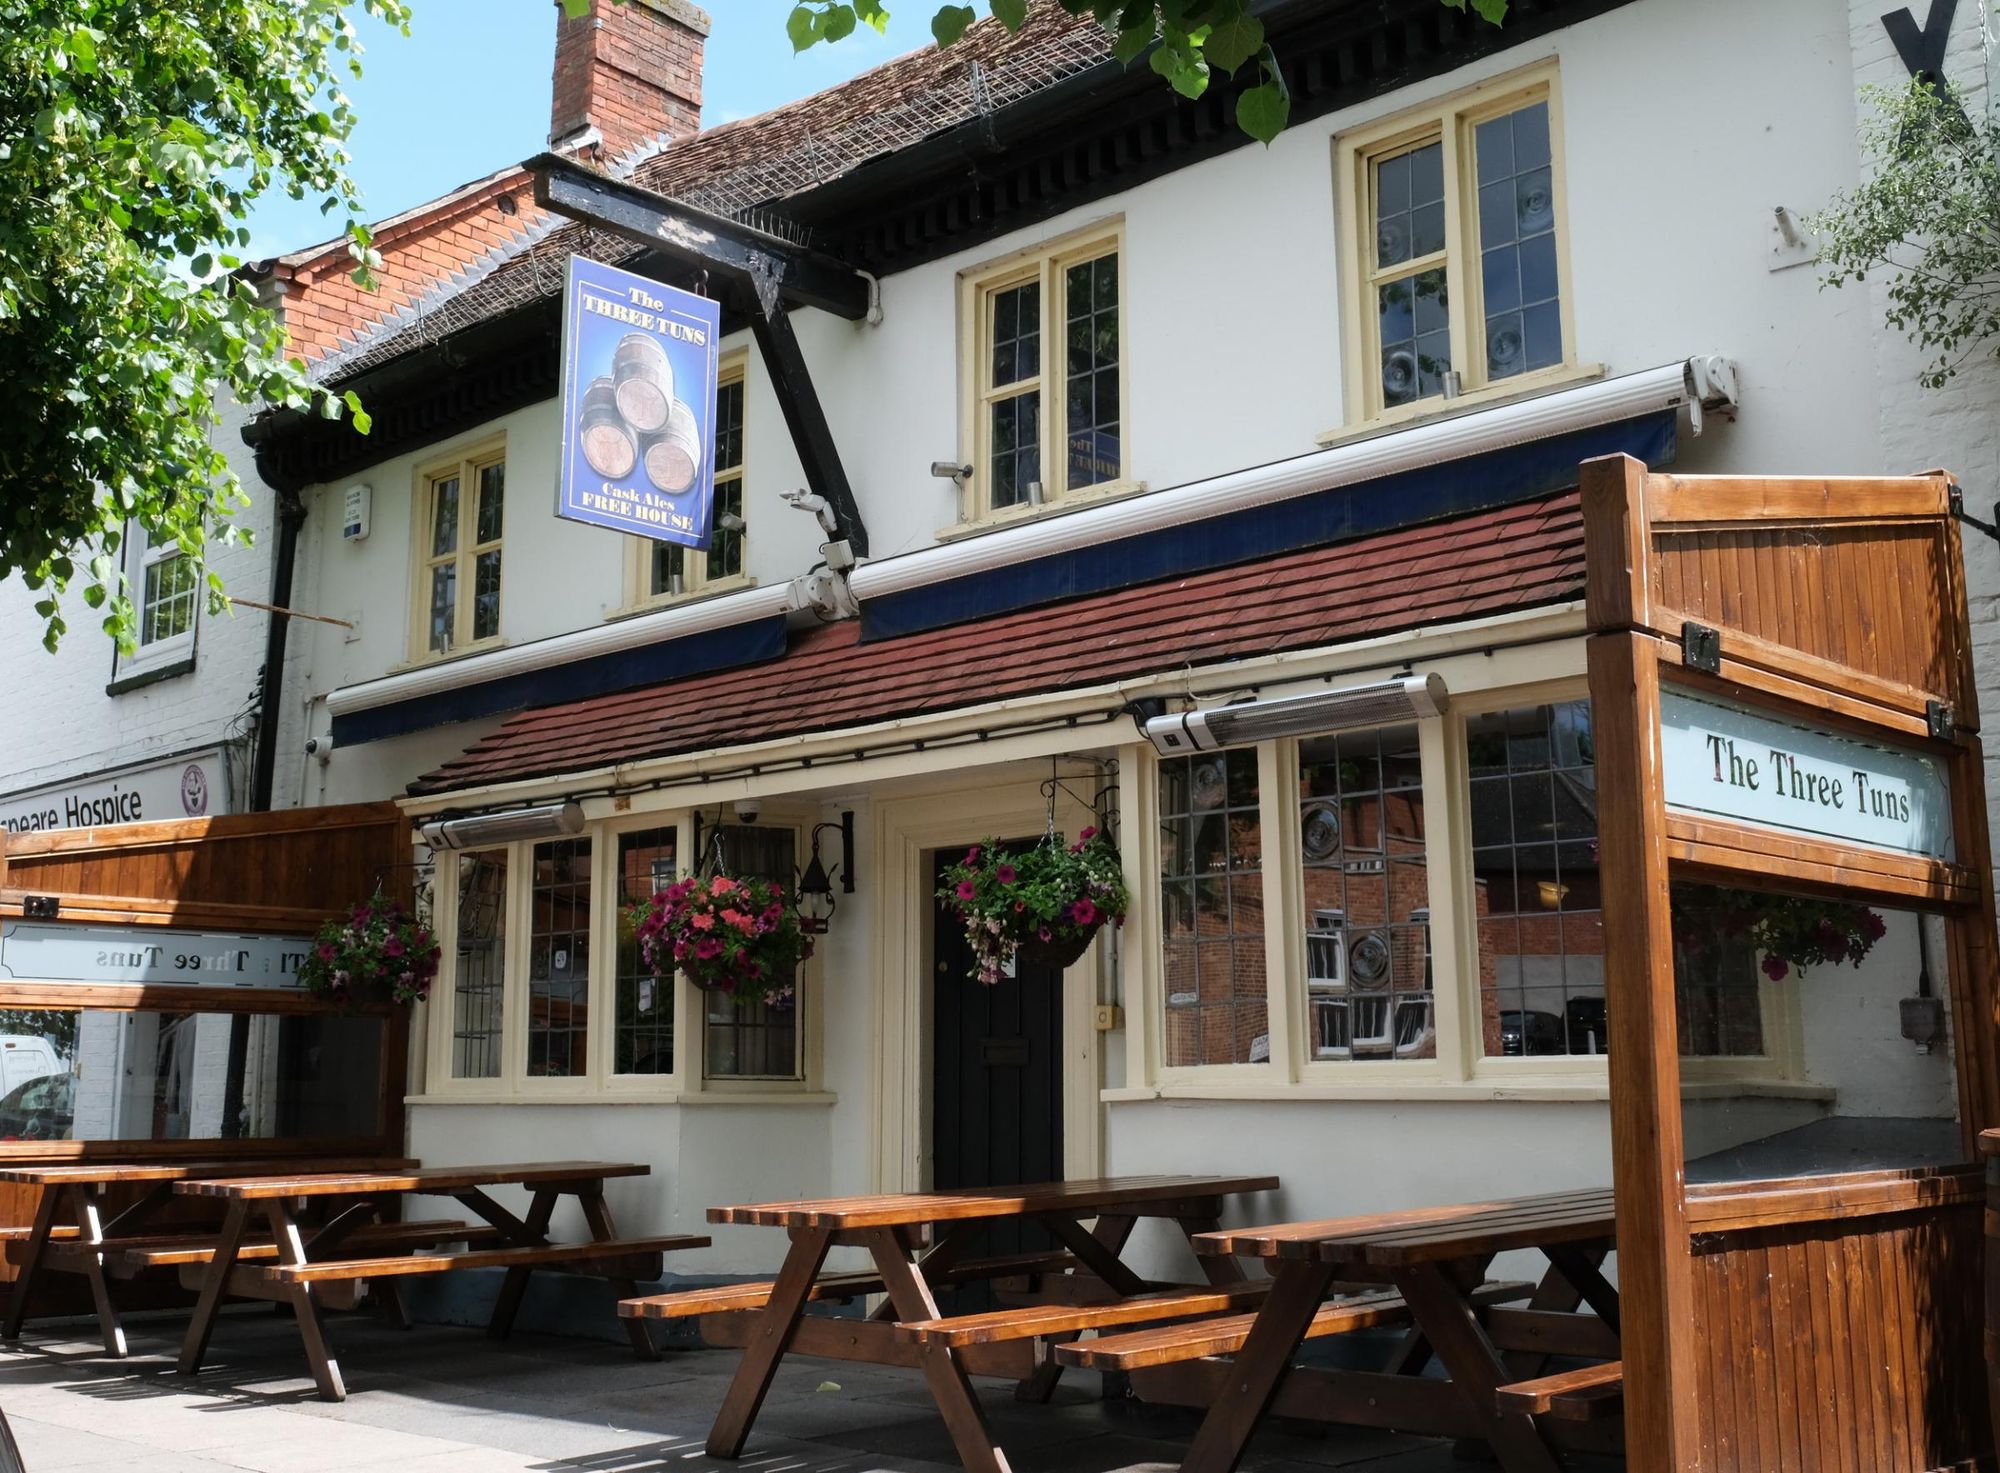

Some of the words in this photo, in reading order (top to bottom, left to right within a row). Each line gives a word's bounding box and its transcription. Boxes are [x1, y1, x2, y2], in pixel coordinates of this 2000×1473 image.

[583, 294, 655, 330] THREE
[656, 317, 706, 346] TUNS
[629, 287, 664, 312] The
[582, 492, 632, 516] FREE
[635, 504, 693, 531] HOUSE
[602, 482, 640, 503] Cask
[643, 493, 675, 511] Ales
[1706, 734, 1760, 790] The
[1769, 750, 1844, 809] Three
[1852, 770, 1910, 823] Tuns
[65, 784, 142, 828] Hospice
